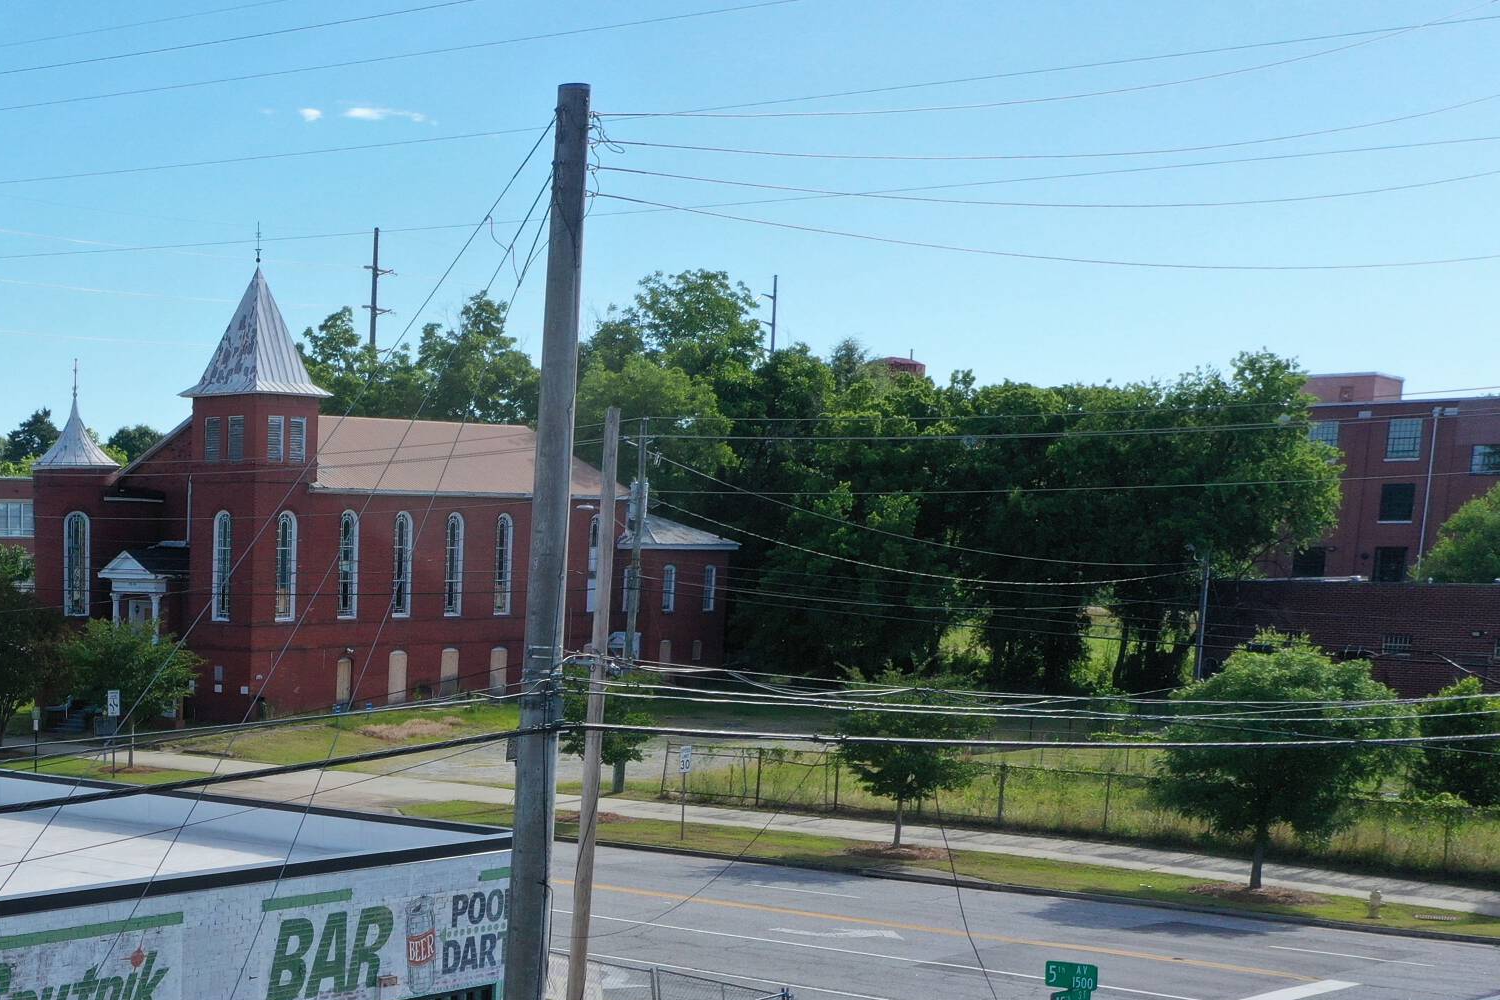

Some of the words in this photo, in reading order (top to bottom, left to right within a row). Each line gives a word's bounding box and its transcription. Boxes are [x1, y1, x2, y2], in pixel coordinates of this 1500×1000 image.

[680, 759, 690, 770] 30
[408, 934, 435, 962] BEER
[1072, 976, 1093, 990] 1500
